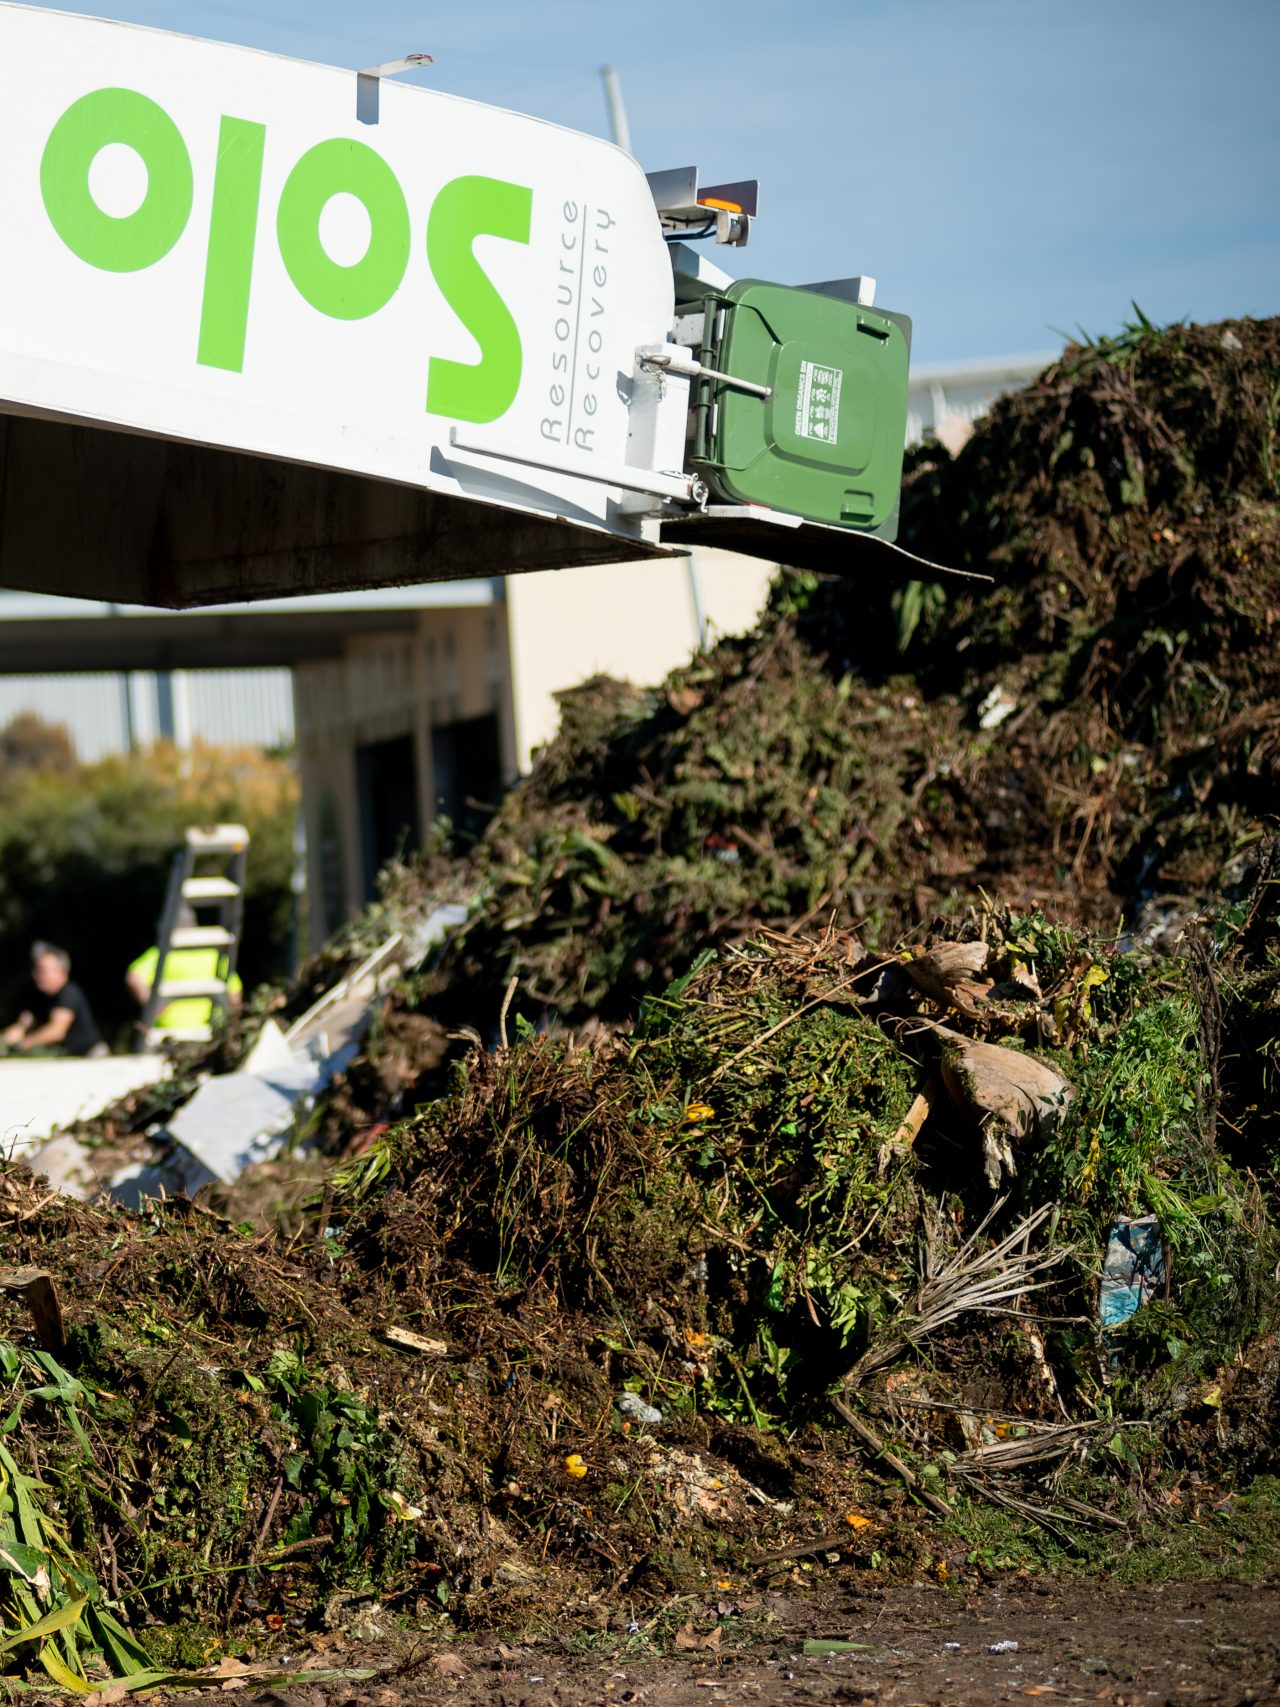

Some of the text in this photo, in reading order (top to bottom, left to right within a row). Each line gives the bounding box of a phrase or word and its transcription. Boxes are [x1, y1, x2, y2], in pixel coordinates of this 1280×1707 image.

[40, 87, 533, 424] Solo
[540, 199, 578, 443] Resource
[574, 207, 616, 452] Recovery
[797, 374, 805, 410] ORGANICS
